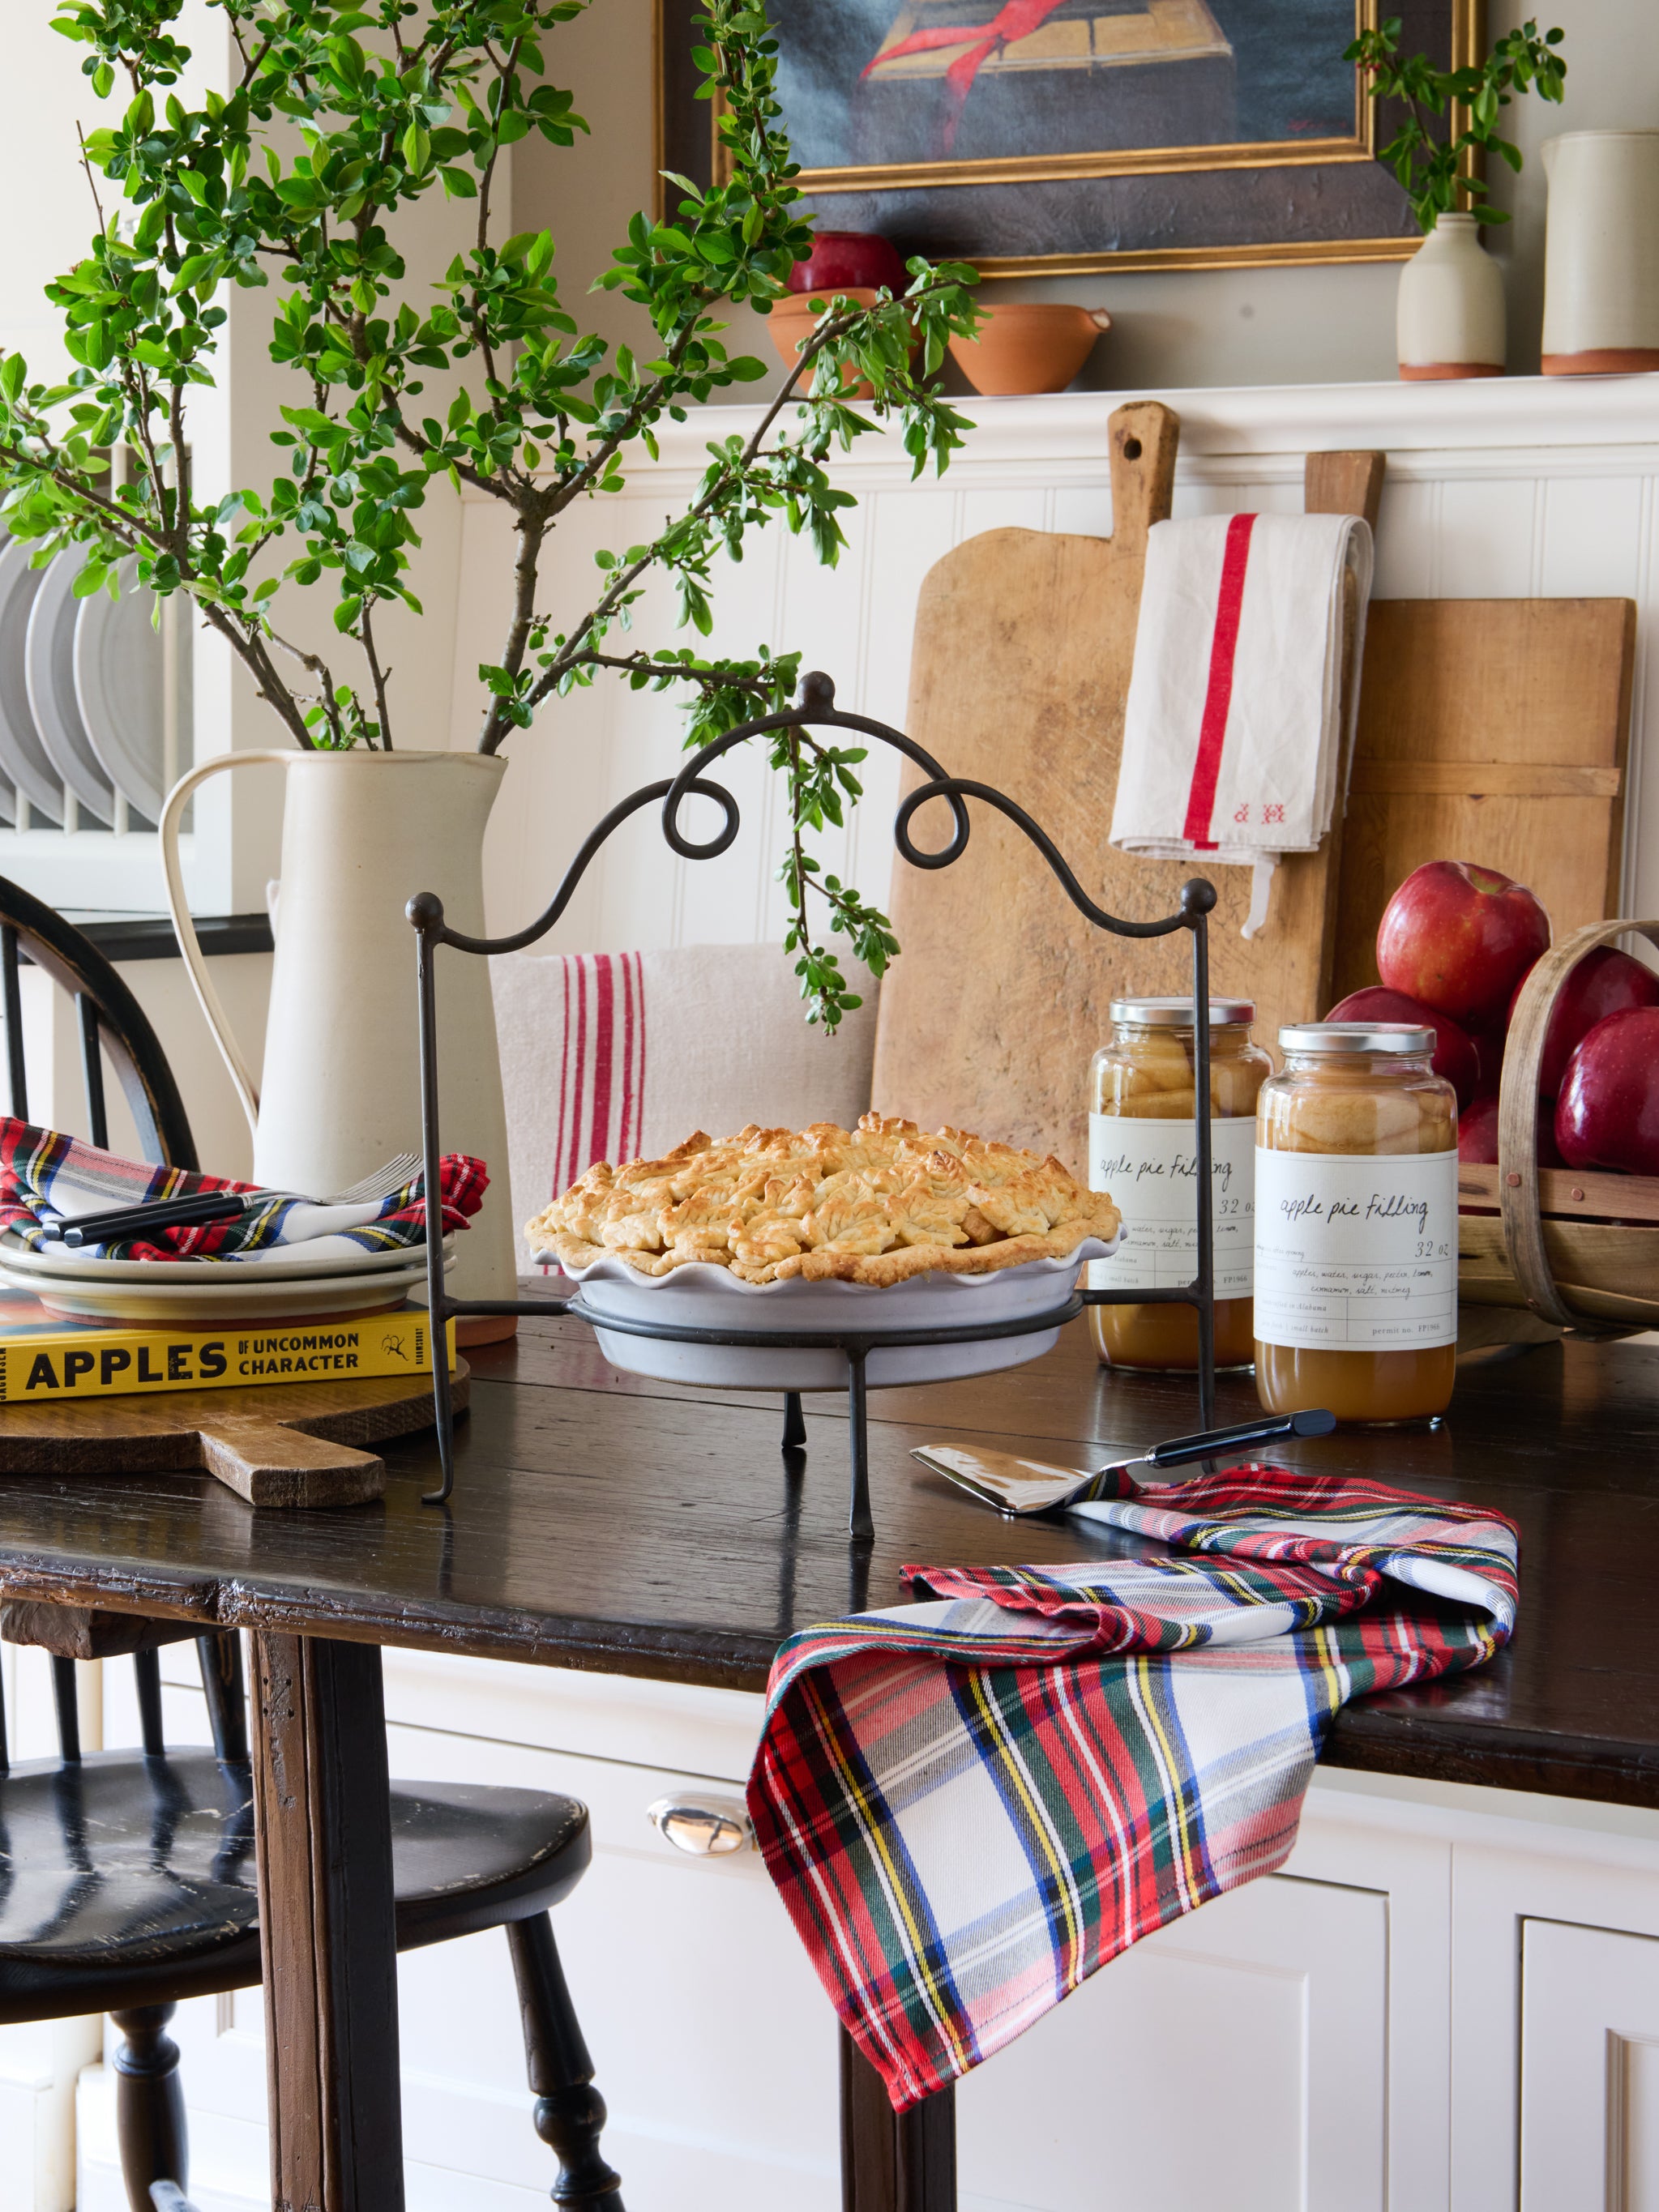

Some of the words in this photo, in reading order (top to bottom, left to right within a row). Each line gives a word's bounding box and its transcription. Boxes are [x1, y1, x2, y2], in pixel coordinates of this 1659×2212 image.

[1101, 1154, 1133, 1180] apple
[1136, 1157, 1165, 1182] pie
[1219, 1198, 1239, 1215] 32
[1281, 1194, 1323, 1222] apple
[1327, 1198, 1360, 1224] pie
[1366, 1194, 1428, 1235] filling
[1415, 1241, 1434, 1258] 32
[1439, 1244, 1449, 1256] oz
[1223, 1275, 1248, 1284] FP1966
[1372, 1326, 1400, 1335] permit
[238, 1339, 250, 1355] OF
[253, 1333, 359, 1354] UNCOMMON
[25, 1341, 228, 1390] APPLES
[238, 1353, 359, 1376] CHARACTER
